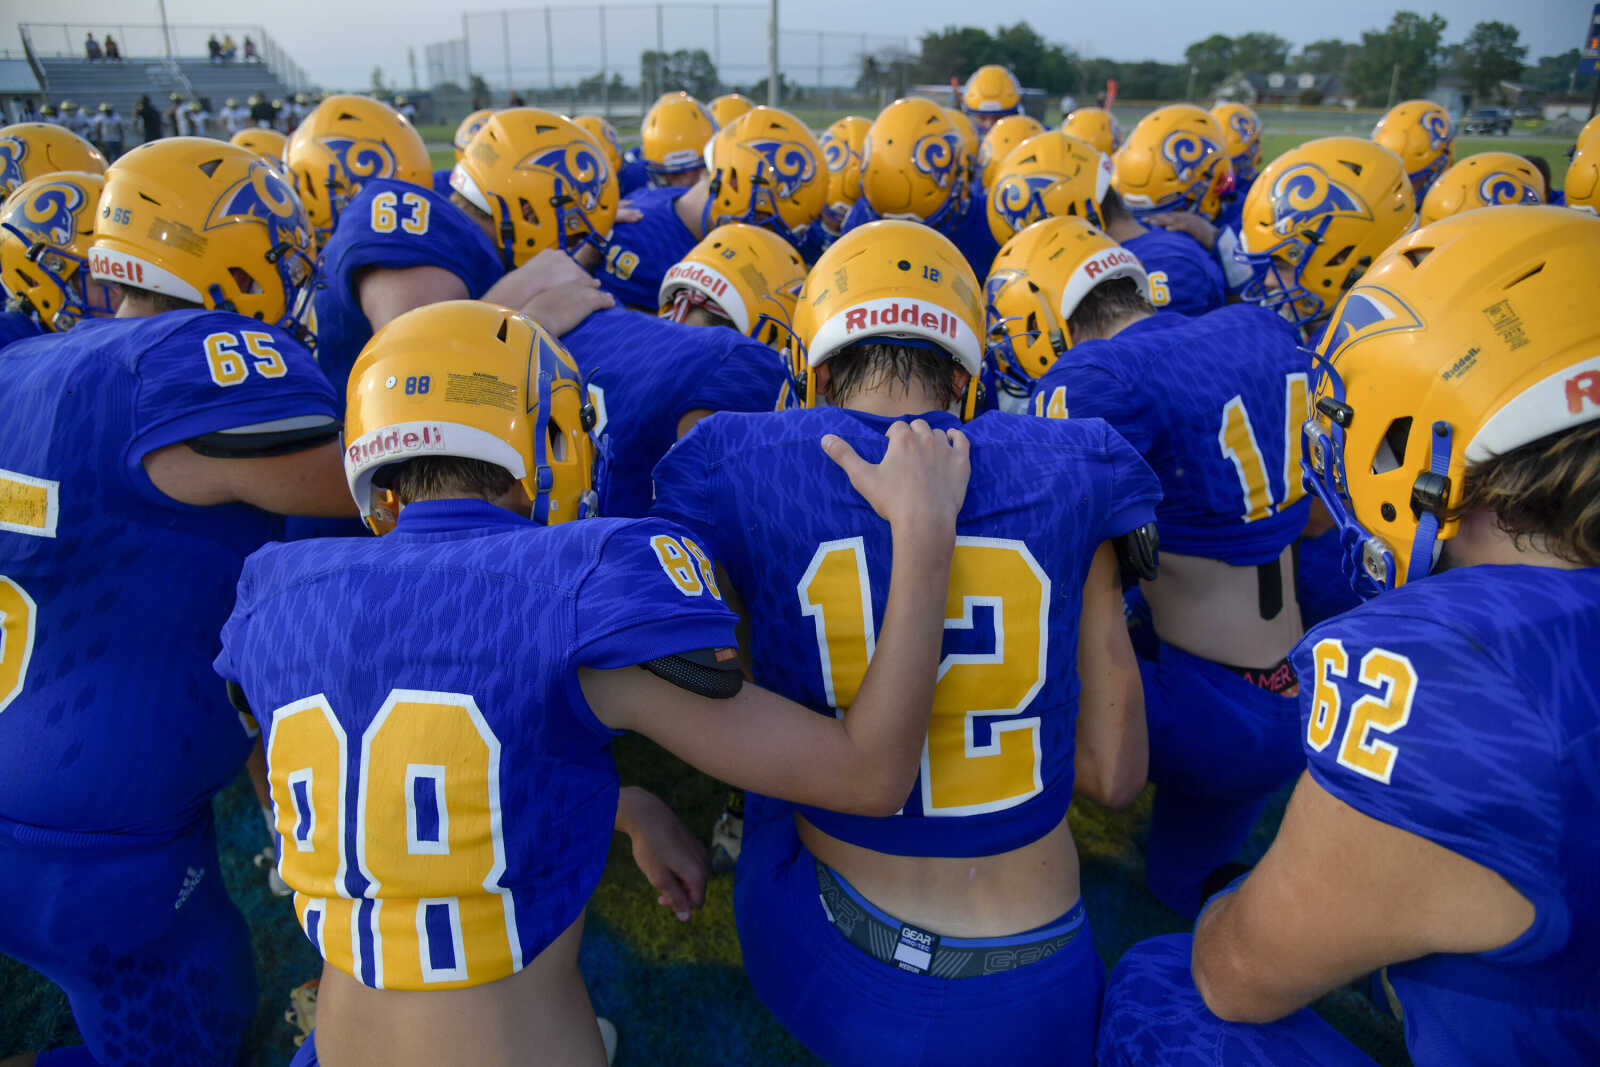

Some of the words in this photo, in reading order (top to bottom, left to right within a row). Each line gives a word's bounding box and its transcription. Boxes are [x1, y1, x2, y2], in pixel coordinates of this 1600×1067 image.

[371, 191, 431, 235] 63
[92, 254, 143, 284] ddell
[667, 264, 728, 297] Riddell
[922, 265, 942, 283] 12
[845, 303, 957, 339] Riddell
[204, 330, 288, 387] 65
[405, 375, 430, 395] 88
[1035, 386, 1069, 419] 14
[650, 534, 722, 600] 88
[797, 536, 1051, 818] 12
[1306, 638, 1418, 784] 62
[902, 927, 931, 946] GEAR
